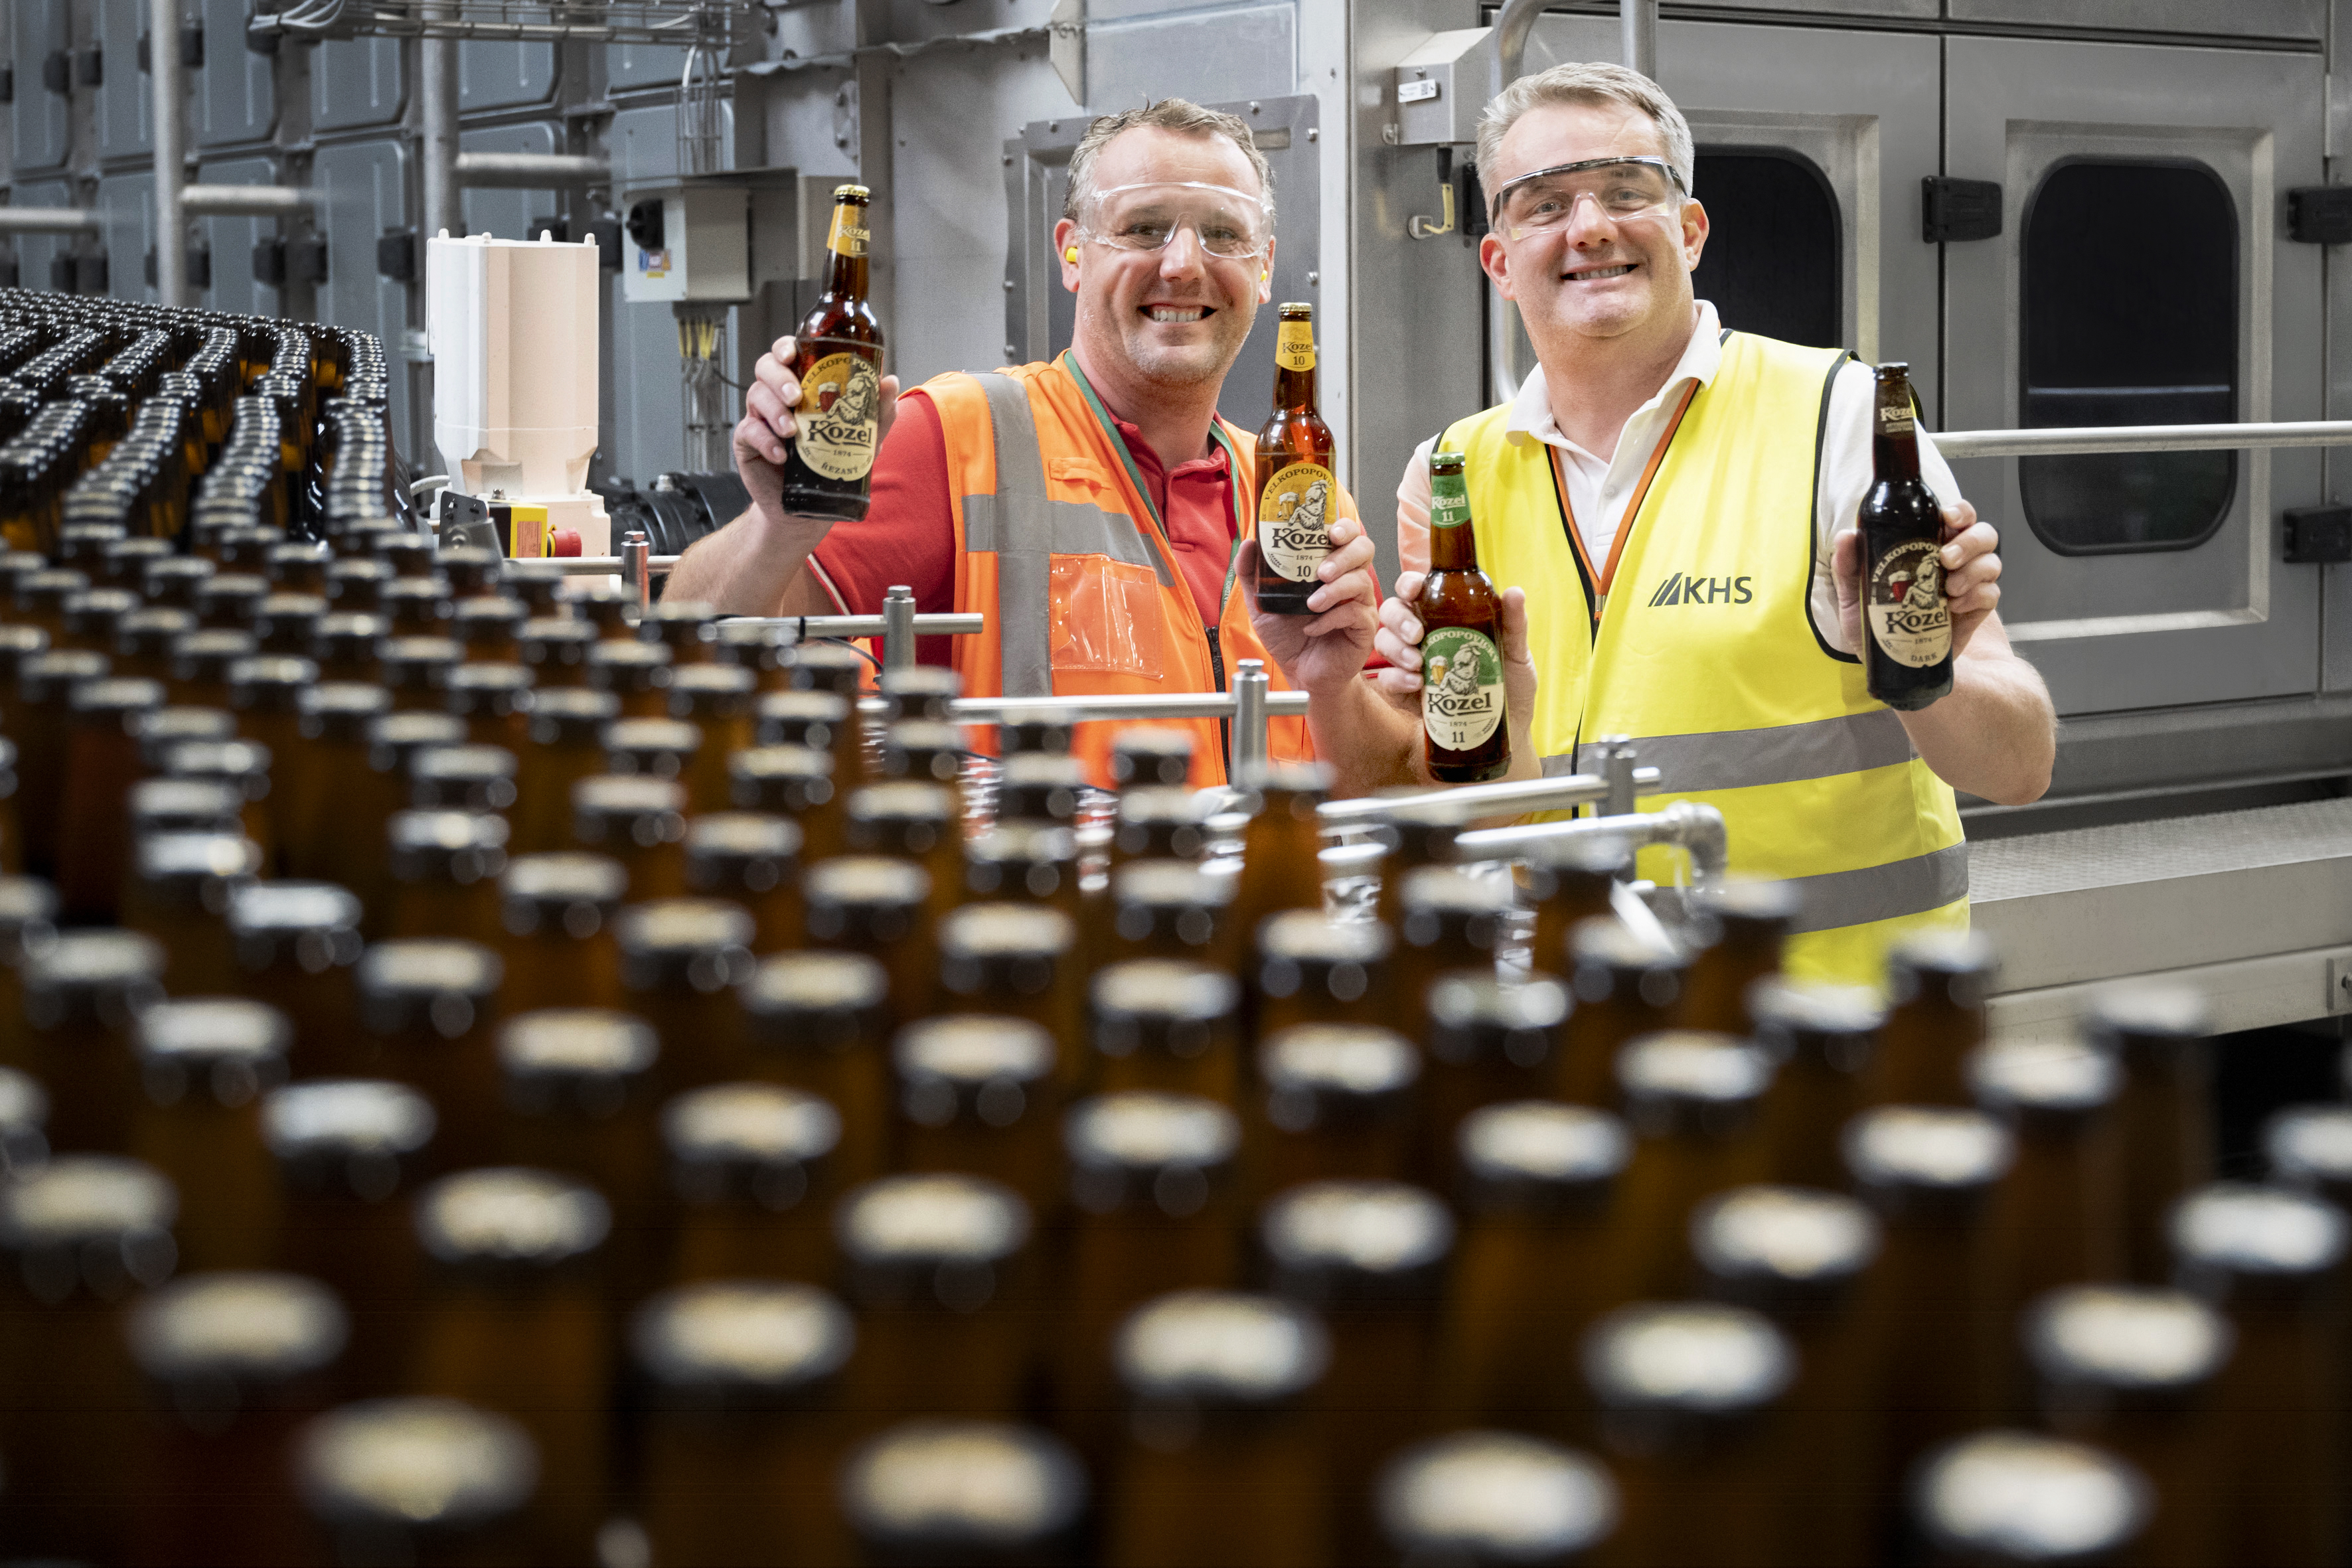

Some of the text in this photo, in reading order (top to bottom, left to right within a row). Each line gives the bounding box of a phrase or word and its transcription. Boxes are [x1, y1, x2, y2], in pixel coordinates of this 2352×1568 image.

[1283, 341, 1313, 354] Kozel
[1293, 355, 1305, 365] 10
[807, 420, 872, 448] Kozel
[1432, 494, 1466, 510] Kozel
[1442, 510, 1454, 522] 11
[1296, 565, 1312, 578] 10
[1684, 576, 1753, 605] KHS
[1885, 605, 1948, 635] Kozel
[1911, 651, 1937, 663] DARK
[1427, 692, 1492, 717] Kozel
[1452, 731, 1466, 744] 11
